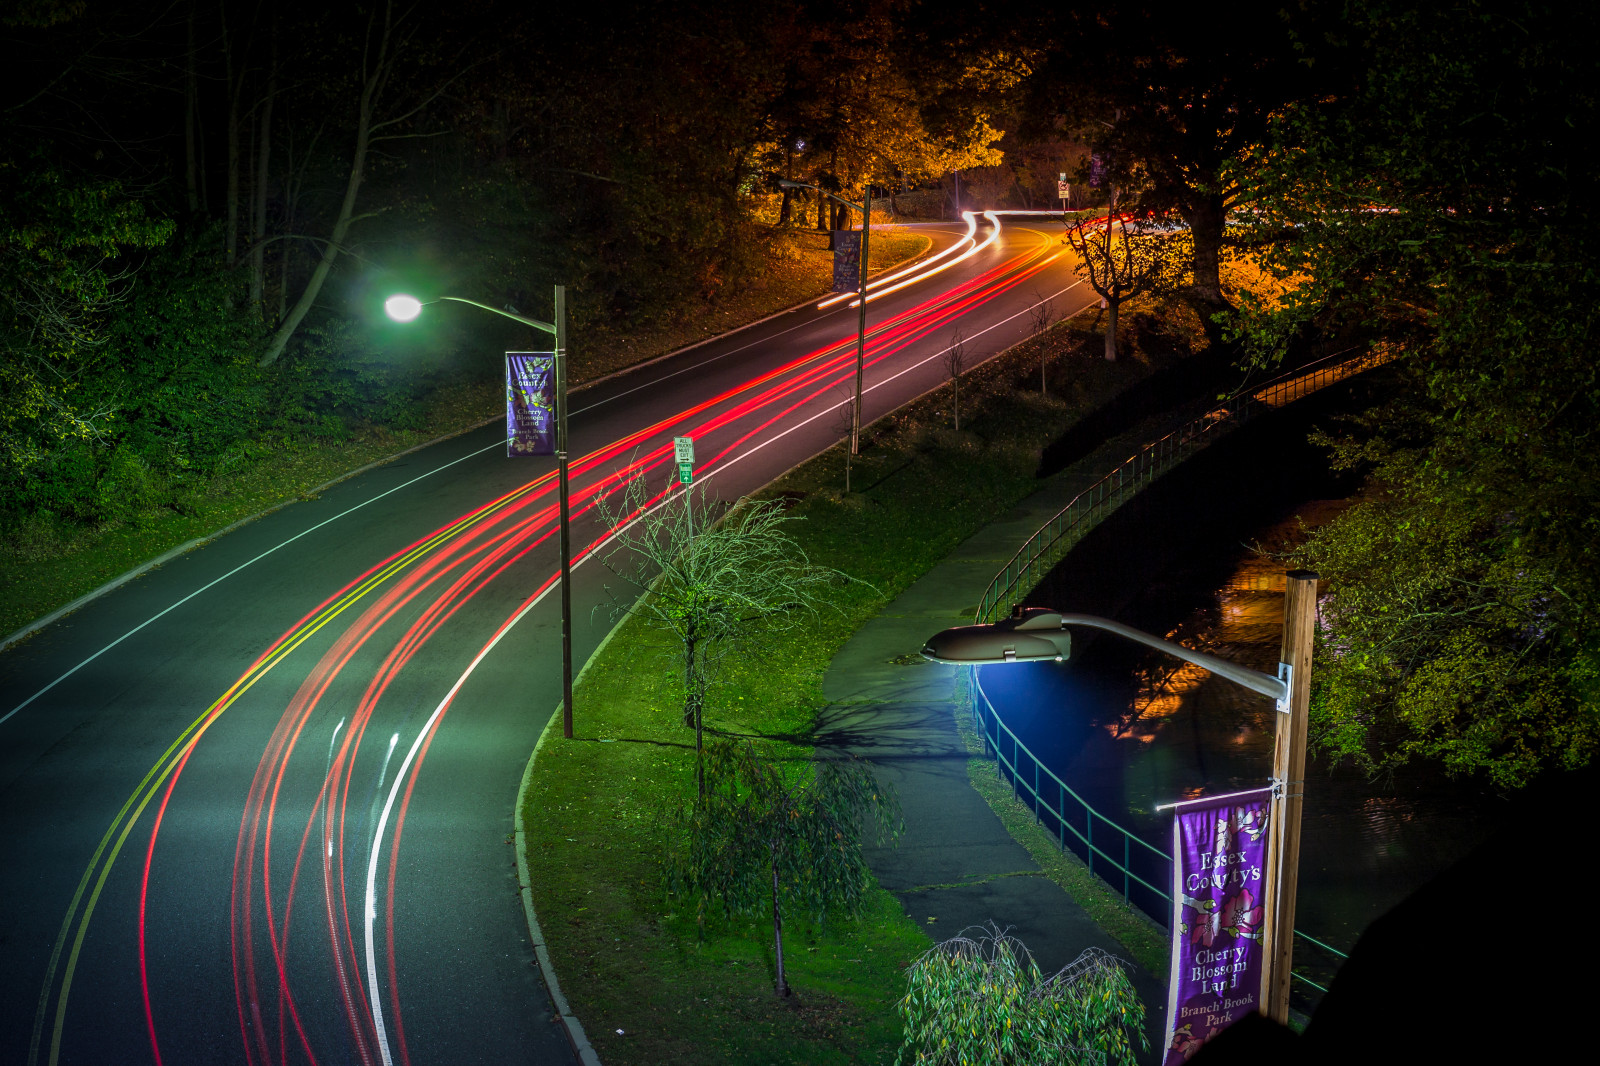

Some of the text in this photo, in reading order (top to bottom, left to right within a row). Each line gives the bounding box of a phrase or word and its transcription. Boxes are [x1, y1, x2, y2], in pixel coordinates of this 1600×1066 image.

[517, 408, 542, 417] Cherry
[1200, 851, 1247, 870] Essex
[1186, 865, 1261, 891] Couty's
[1195, 946, 1245, 965] Cherry
[1192, 961, 1247, 982] Blossom
[1201, 973, 1237, 994] Land
[1180, 993, 1254, 1018] Branch Brook
[1205, 1011, 1233, 1027] Park
